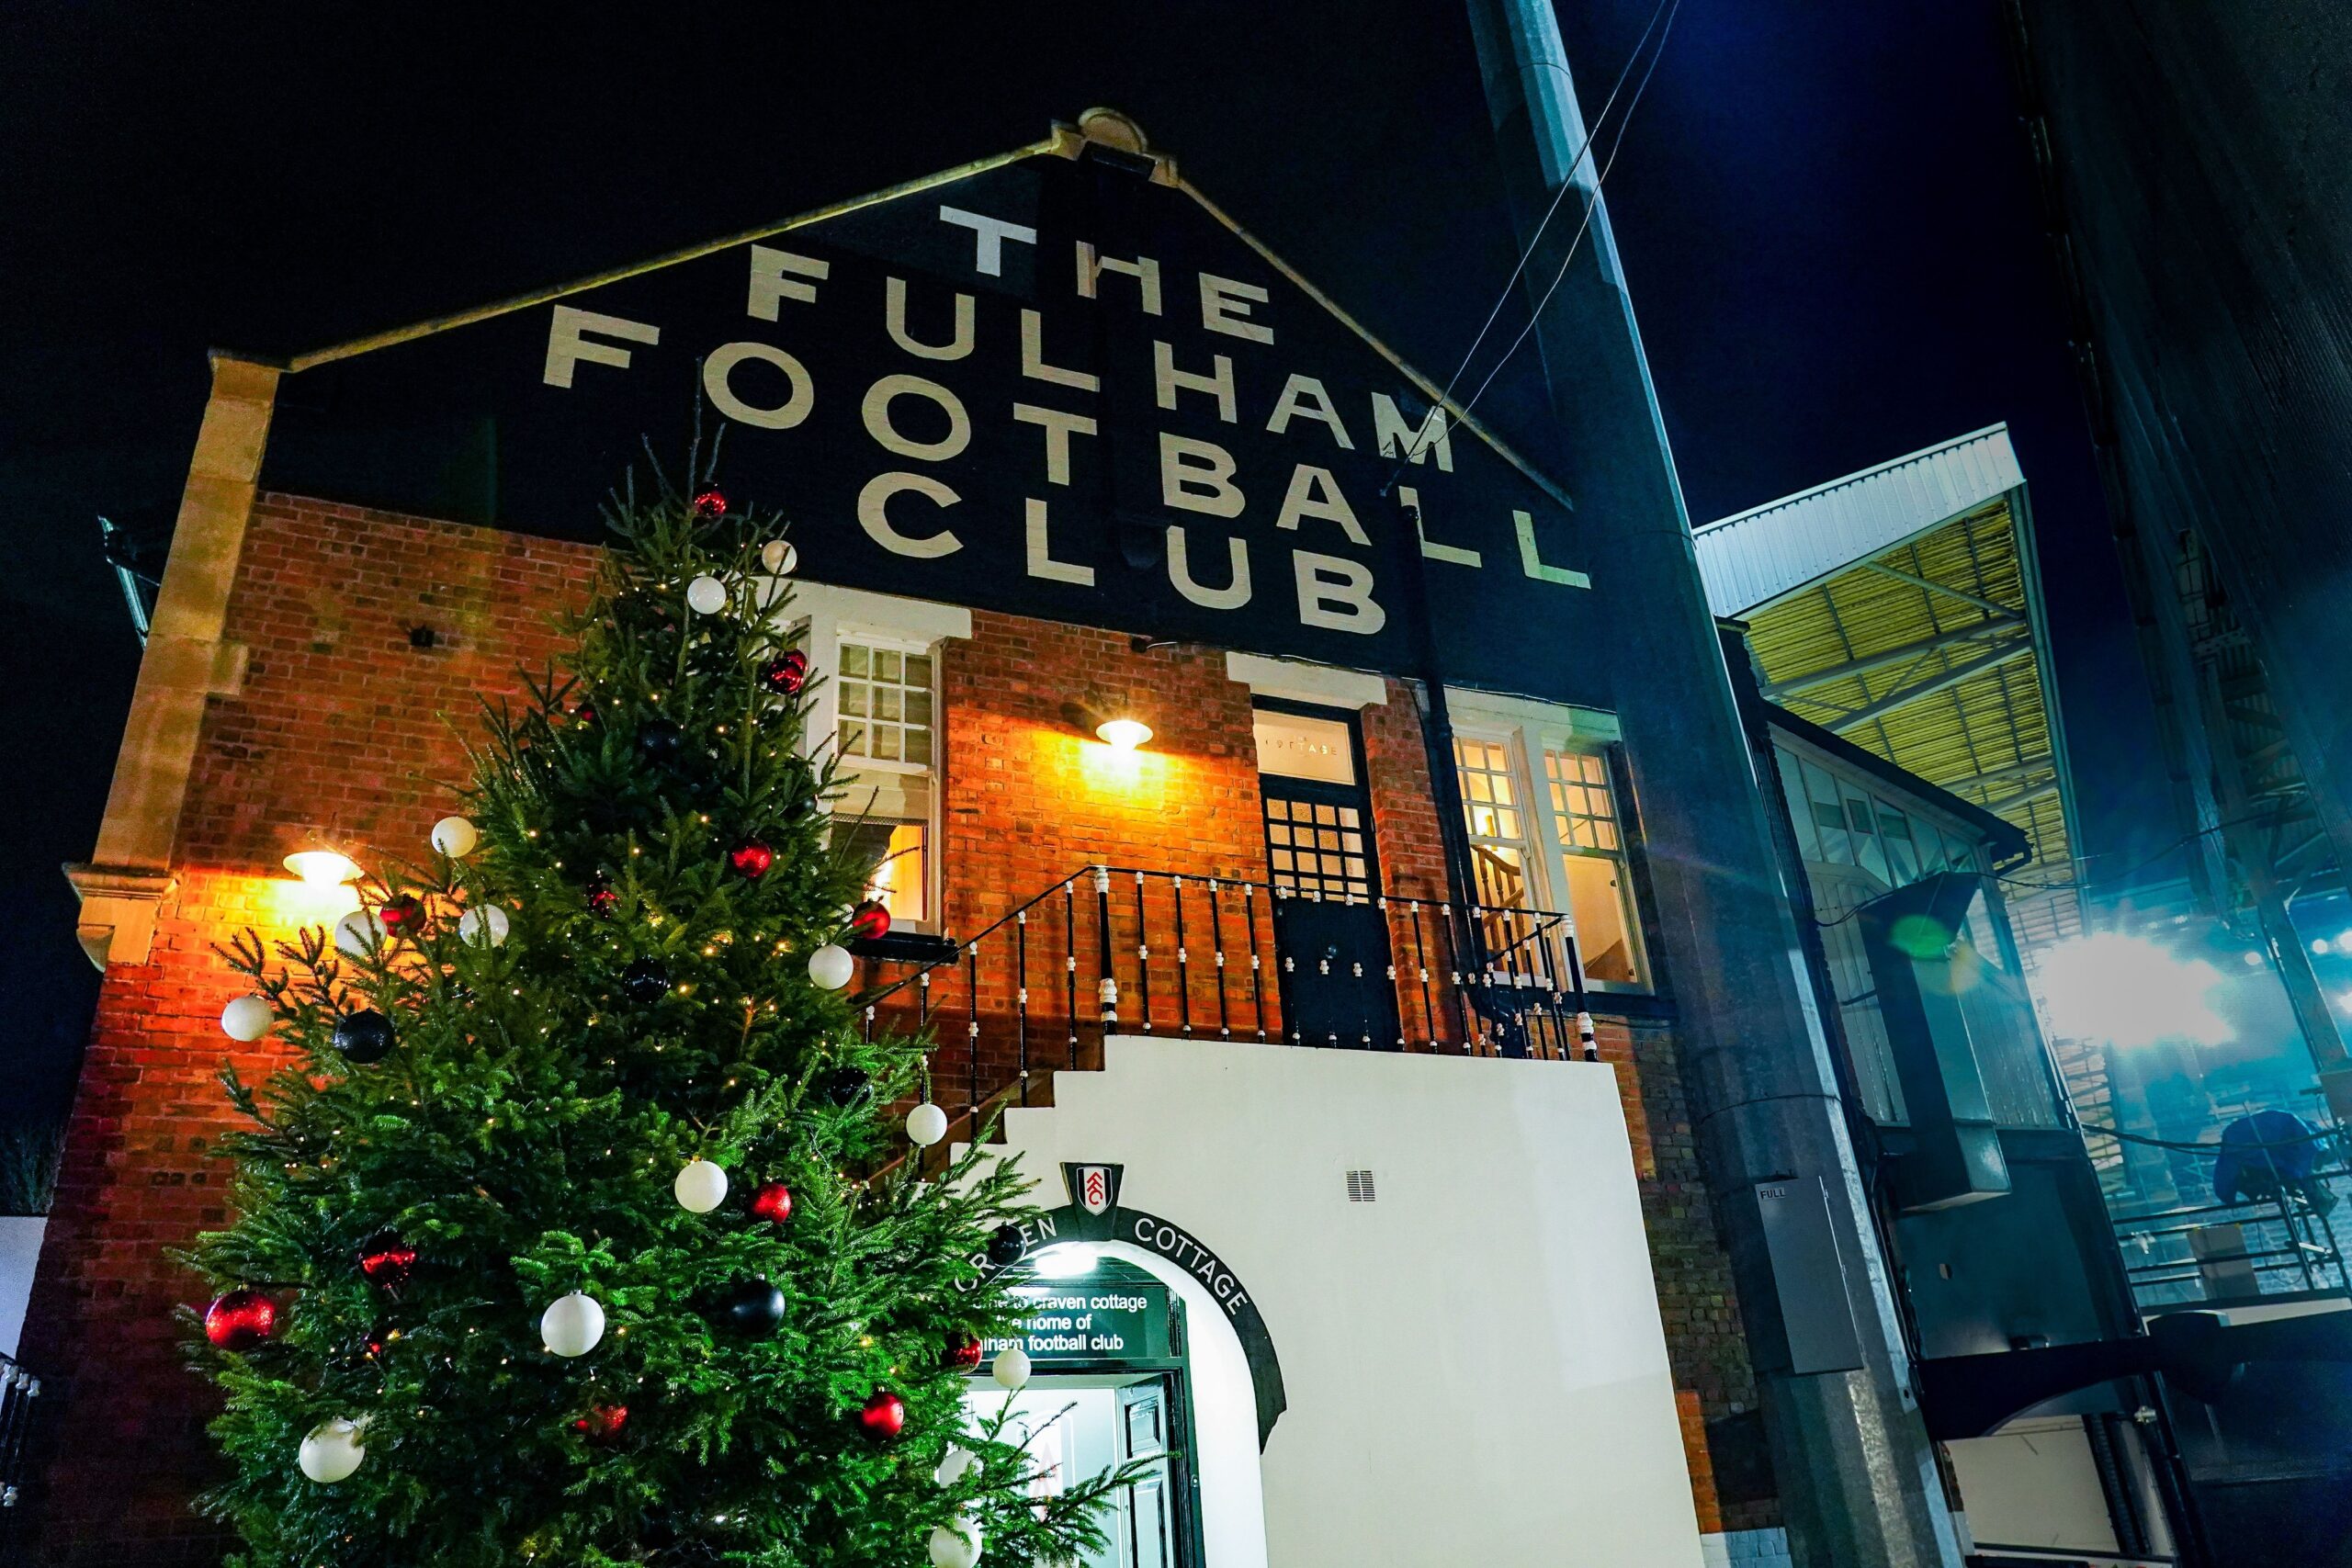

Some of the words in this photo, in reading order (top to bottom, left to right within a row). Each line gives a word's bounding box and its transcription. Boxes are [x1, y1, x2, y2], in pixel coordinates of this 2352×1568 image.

[939, 205, 1274, 344] THE
[747, 243, 1453, 472] FULHAM
[543, 305, 1591, 589] FOOTBALL
[858, 471, 1385, 635] CLUB
[1086, 1171, 1102, 1205] FFC
[1760, 1189, 1785, 1200] FULL
[955, 1216, 1057, 1292] CREN
[1135, 1218, 1248, 1315] COTTAGE
[1033, 1296, 1086, 1310] craven
[1091, 1294, 1148, 1314] cottage
[1076, 1314, 1092, 1330] of
[1028, 1335, 1087, 1351] football
[1091, 1334, 1125, 1350] club
